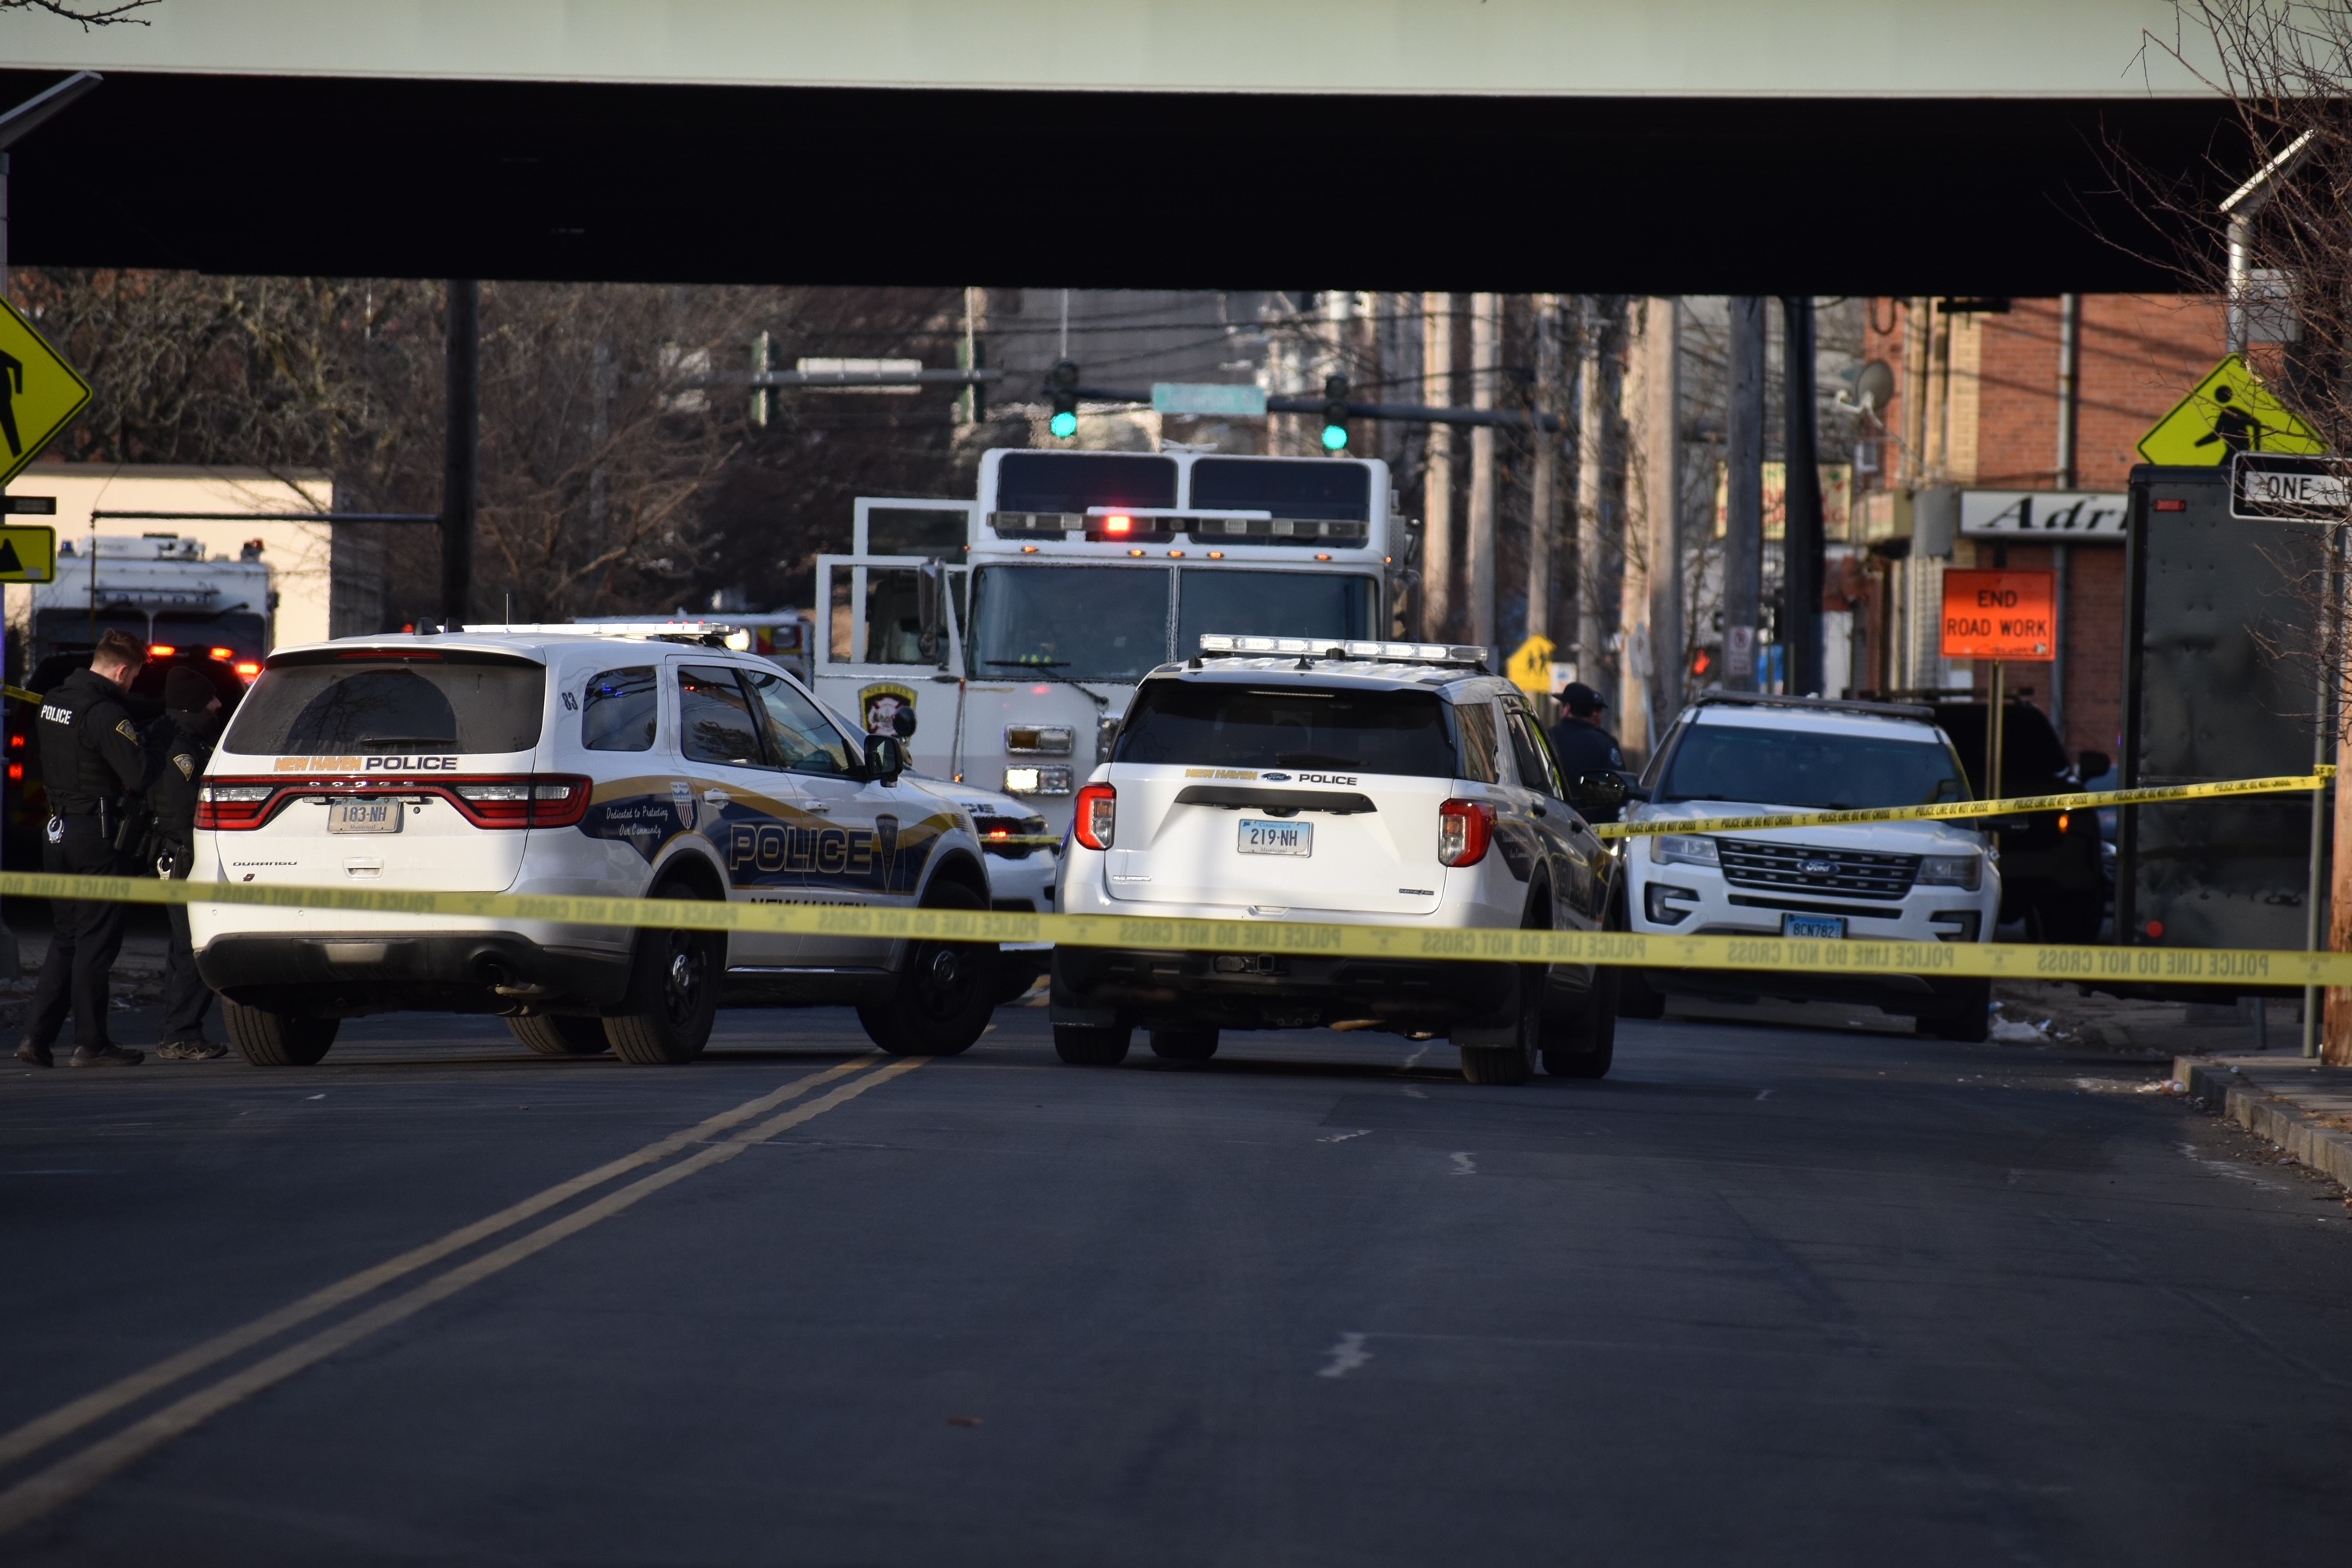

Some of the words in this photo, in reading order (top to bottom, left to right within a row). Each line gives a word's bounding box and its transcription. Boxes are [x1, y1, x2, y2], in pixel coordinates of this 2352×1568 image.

[2267, 476, 2311, 500] ONE
[1978, 590, 2018, 608] END
[1947, 618, 1991, 637] ROAD
[1999, 618, 2047, 637] WORK
[562, 692, 578, 710] 83
[41, 704, 72, 724] POLICE
[274, 757, 309, 771] NEW
[309, 757, 362, 771] HAVEN
[366, 757, 458, 770] POLICE
[1185, 768, 1215, 779] NEW
[1215, 769, 1258, 781] HAVEN
[1299, 774, 1358, 786] POLICE
[607, 808, 633, 819] Dedicated
[634, 808, 641, 818] to
[643, 805, 668, 821] Protecting
[1818, 812, 1837, 822] POLICE
[1838, 811, 1849, 822] LINE
[1852, 811, 1858, 821] DO
[1860, 810, 1871, 820] NOT
[1873, 809, 1890, 819] CROSS
[1915, 806, 1934, 816] POLICE
[1958, 804, 1969, 814] NOT
[1971, 802, 1989, 812] CROSS
[1625, 823, 1644, 833] POLICE
[1646, 822, 1656, 832] LINE
[1658, 822, 1665, 831] DO
[1667, 822, 1678, 831] NOT
[1679, 820, 1696, 831] CROSS
[1721, 818, 1740, 828] POLICE
[1742, 818, 1753, 827] LINE
[1755, 818, 1762, 826] DO
[1762, 816, 1773, 826] NOT
[1775, 815, 1793, 825] CROSS
[619, 824, 630, 836] Our
[632, 823, 661, 839] Community
[730, 823, 874, 874] POLICE
